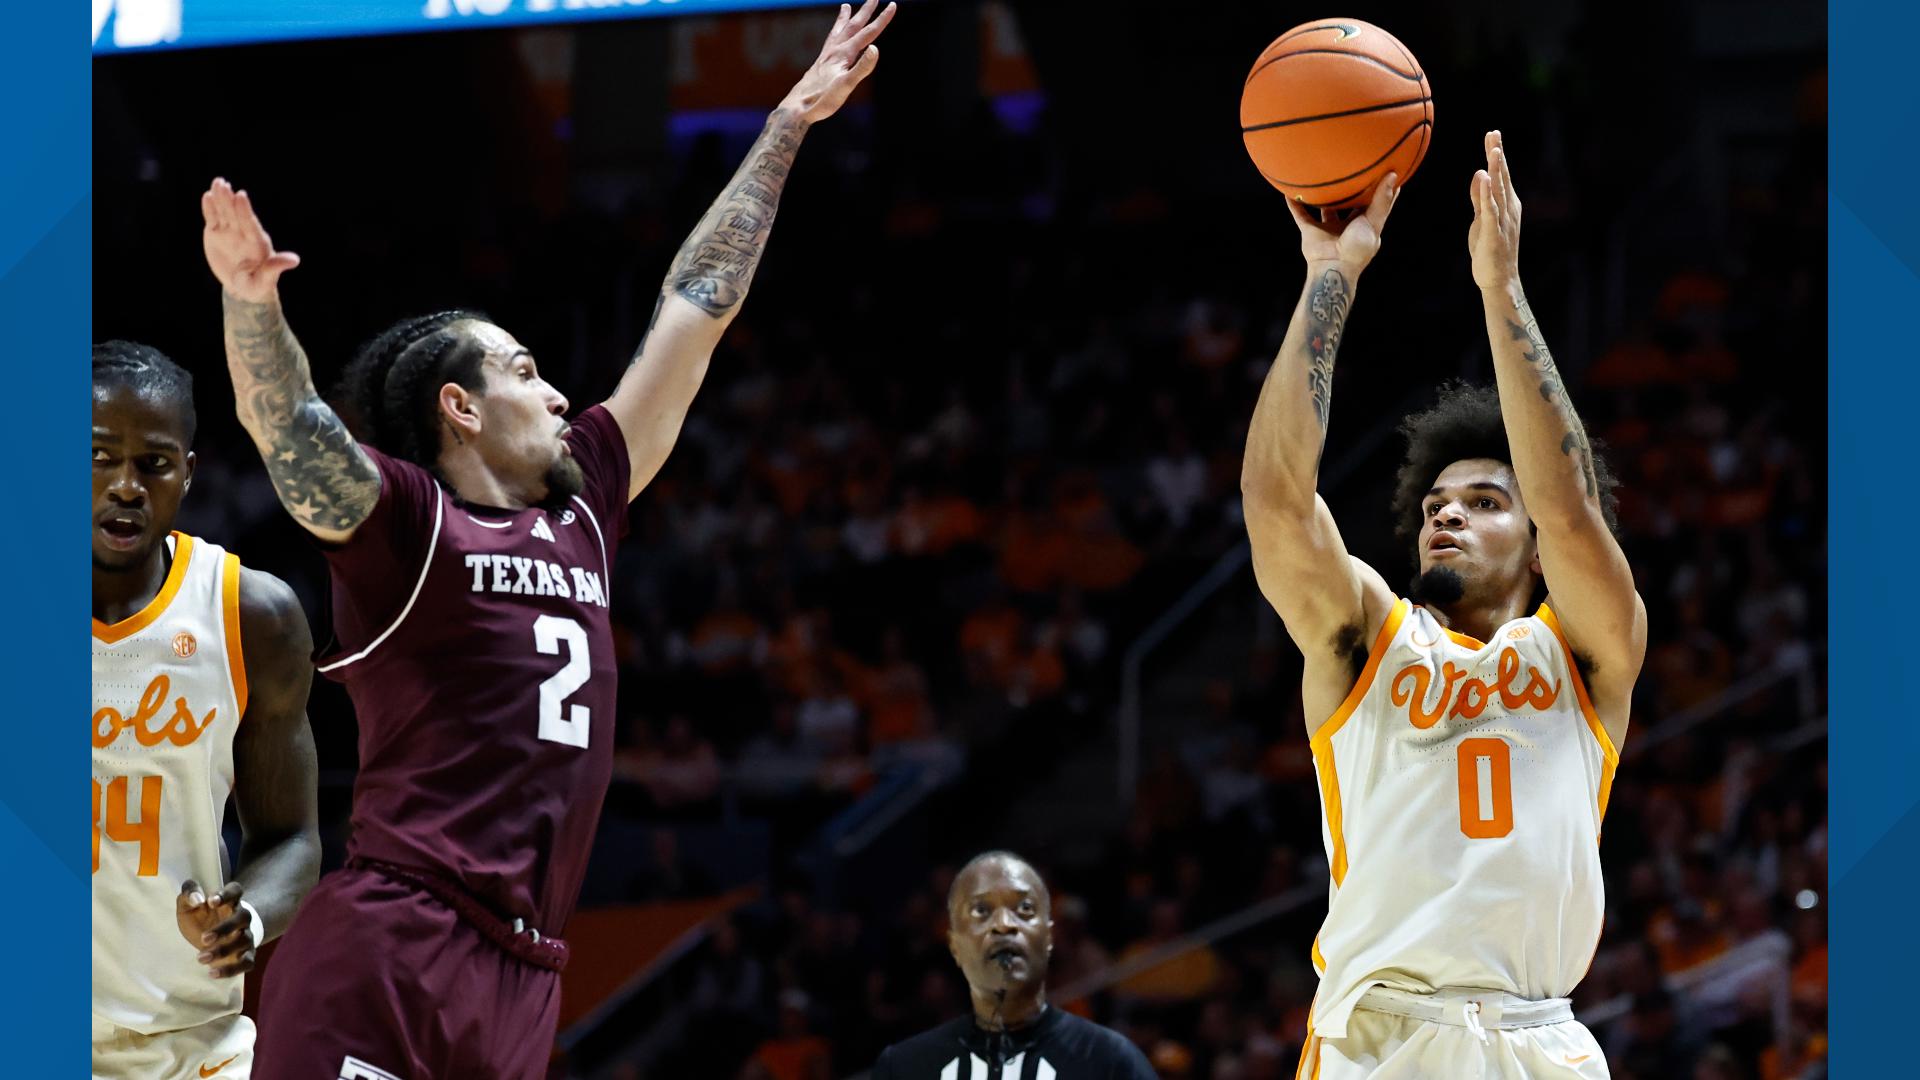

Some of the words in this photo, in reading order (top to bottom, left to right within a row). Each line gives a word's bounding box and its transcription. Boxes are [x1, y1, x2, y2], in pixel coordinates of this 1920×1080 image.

[465, 554, 571, 599] TEXAS
[172, 631, 197, 657] SEC
[533, 614, 591, 750] 2
[92, 674, 217, 747] ols
[1391, 646, 1562, 729] Vols
[92, 775, 163, 876] 4
[1457, 738, 1514, 839] 0
